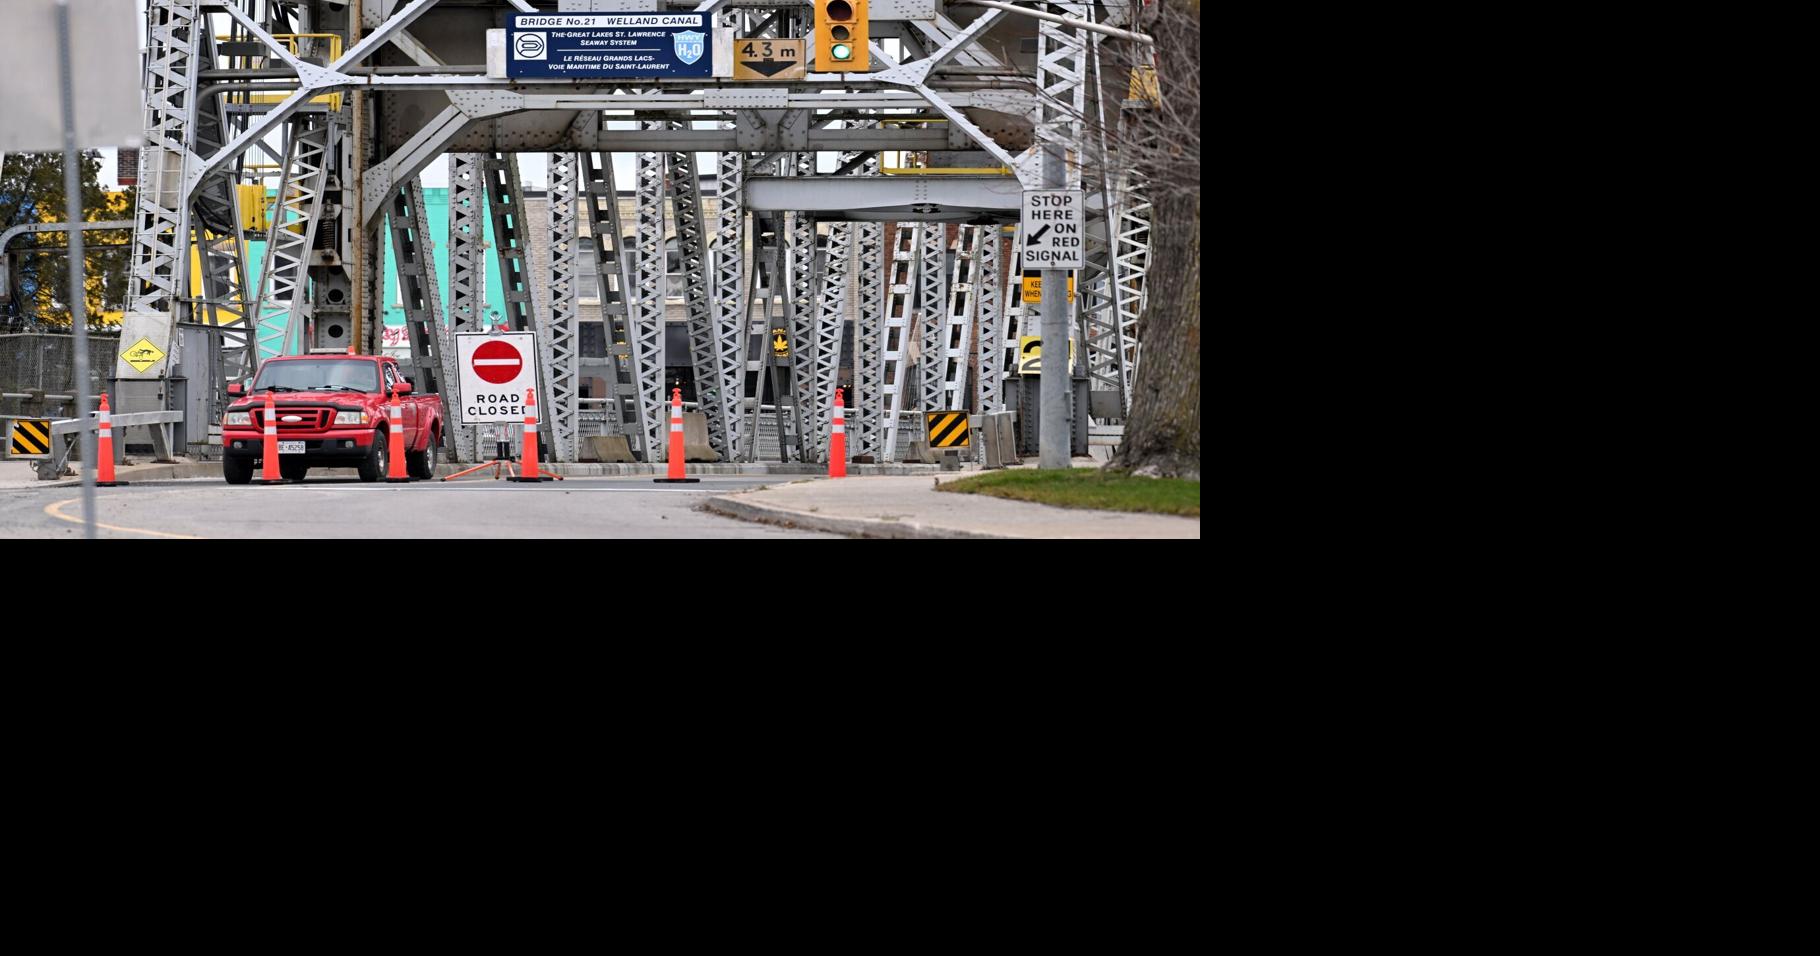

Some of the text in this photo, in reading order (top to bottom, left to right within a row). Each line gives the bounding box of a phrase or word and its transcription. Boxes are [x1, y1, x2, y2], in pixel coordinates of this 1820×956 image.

[520, 16, 699, 26] BRIDGE No.21 WELLAND CANAL
[742, 41, 796, 58] 4.3 m
[574, 54, 602, 62] RÉSEAU
[1031, 195, 1073, 207] STOP
[1031, 210, 1073, 220] HERE
[1054, 223, 1077, 234] ON
[1052, 237, 1080, 247] RED
[1025, 250, 1080, 262] SIGNAL
[1030, 281, 1043, 289] KEE
[476, 394, 520, 404] ROAD
